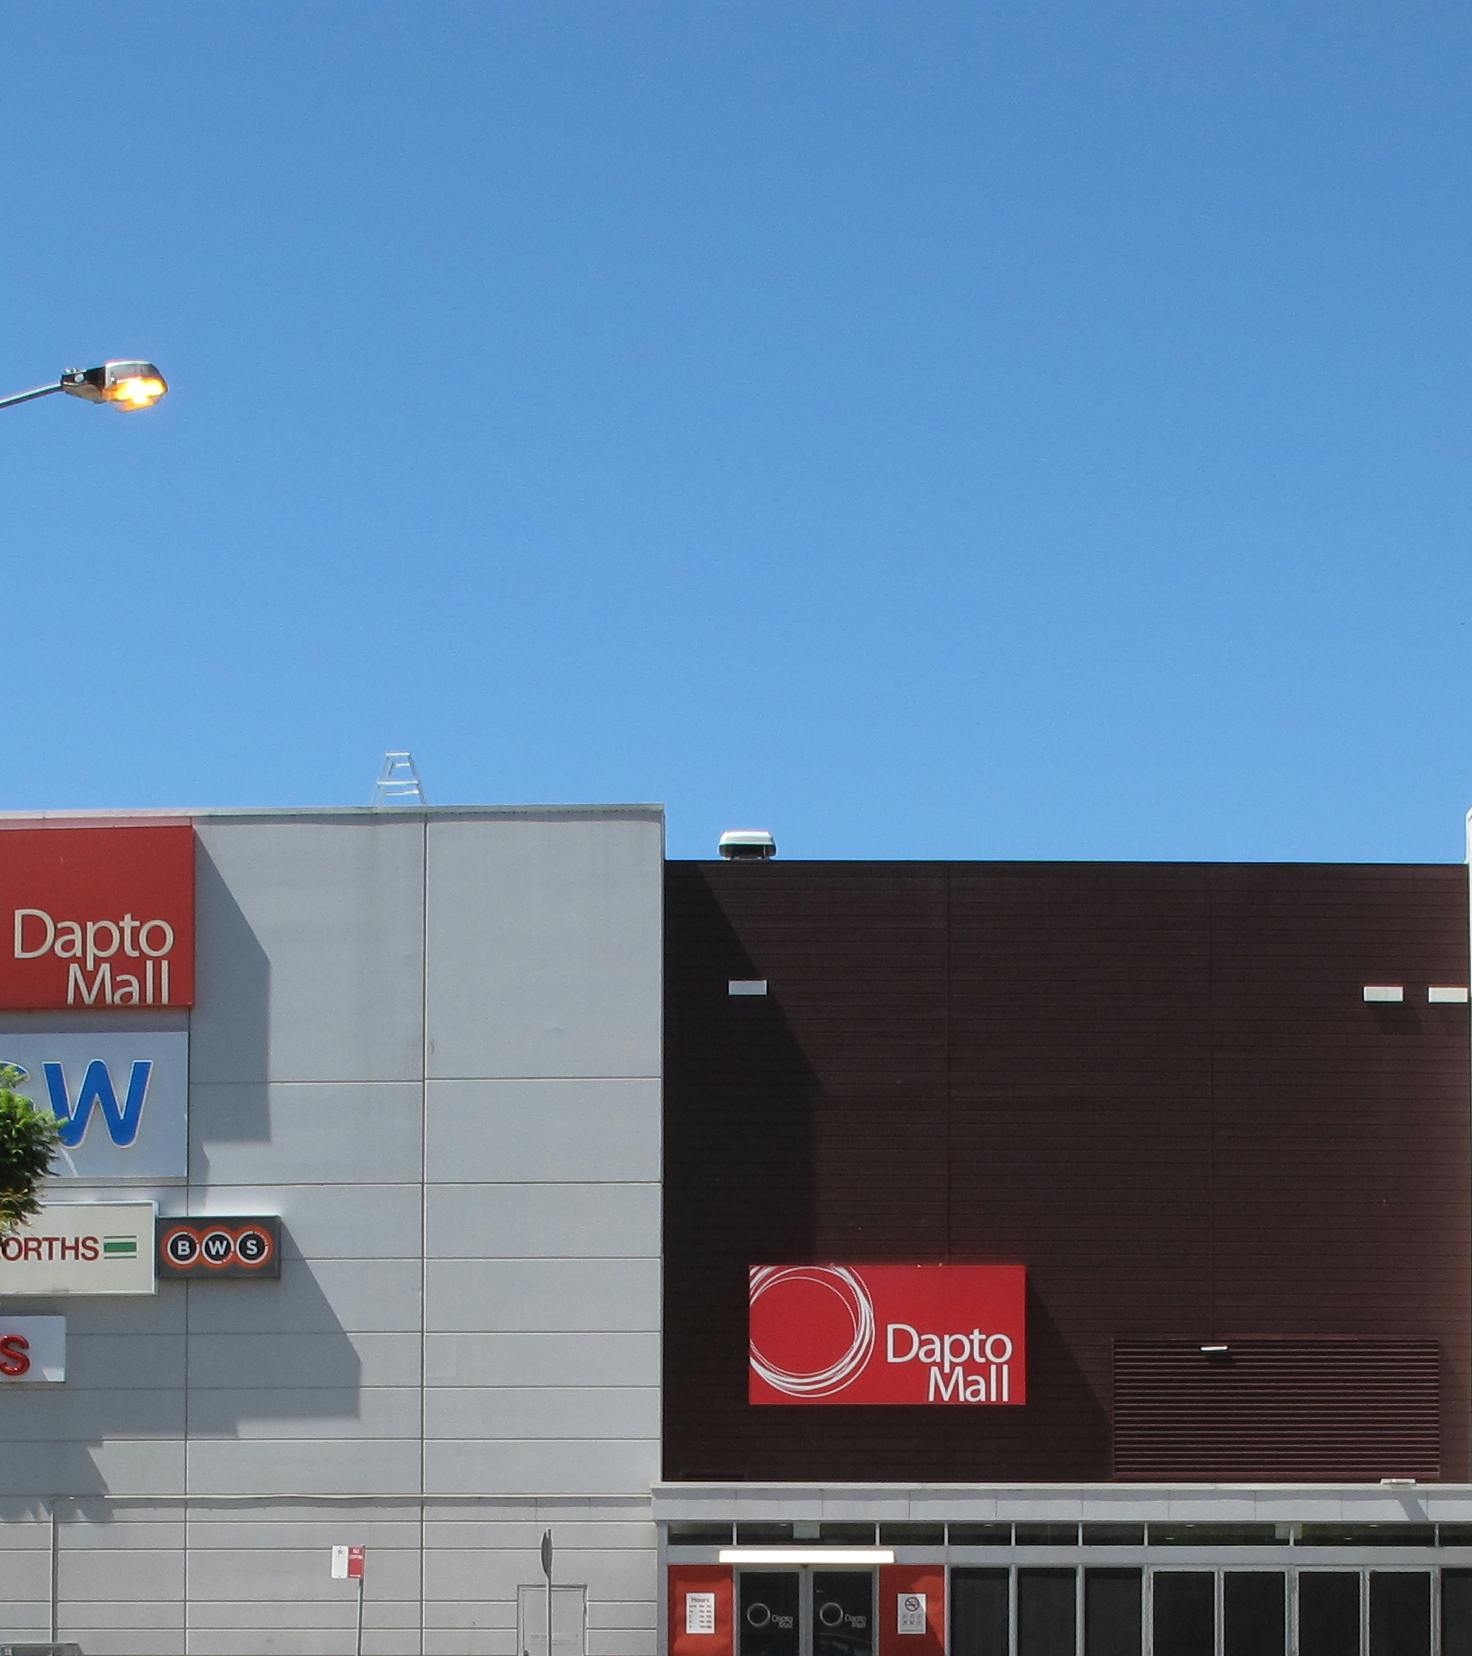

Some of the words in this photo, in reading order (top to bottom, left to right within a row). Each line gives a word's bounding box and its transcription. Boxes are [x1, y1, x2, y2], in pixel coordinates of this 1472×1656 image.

[14, 909, 175, 971] Dapto
[67, 960, 169, 1005] Mall
[886, 1323, 1013, 1373] Dapto
[928, 1365, 1009, 1402] Mall
